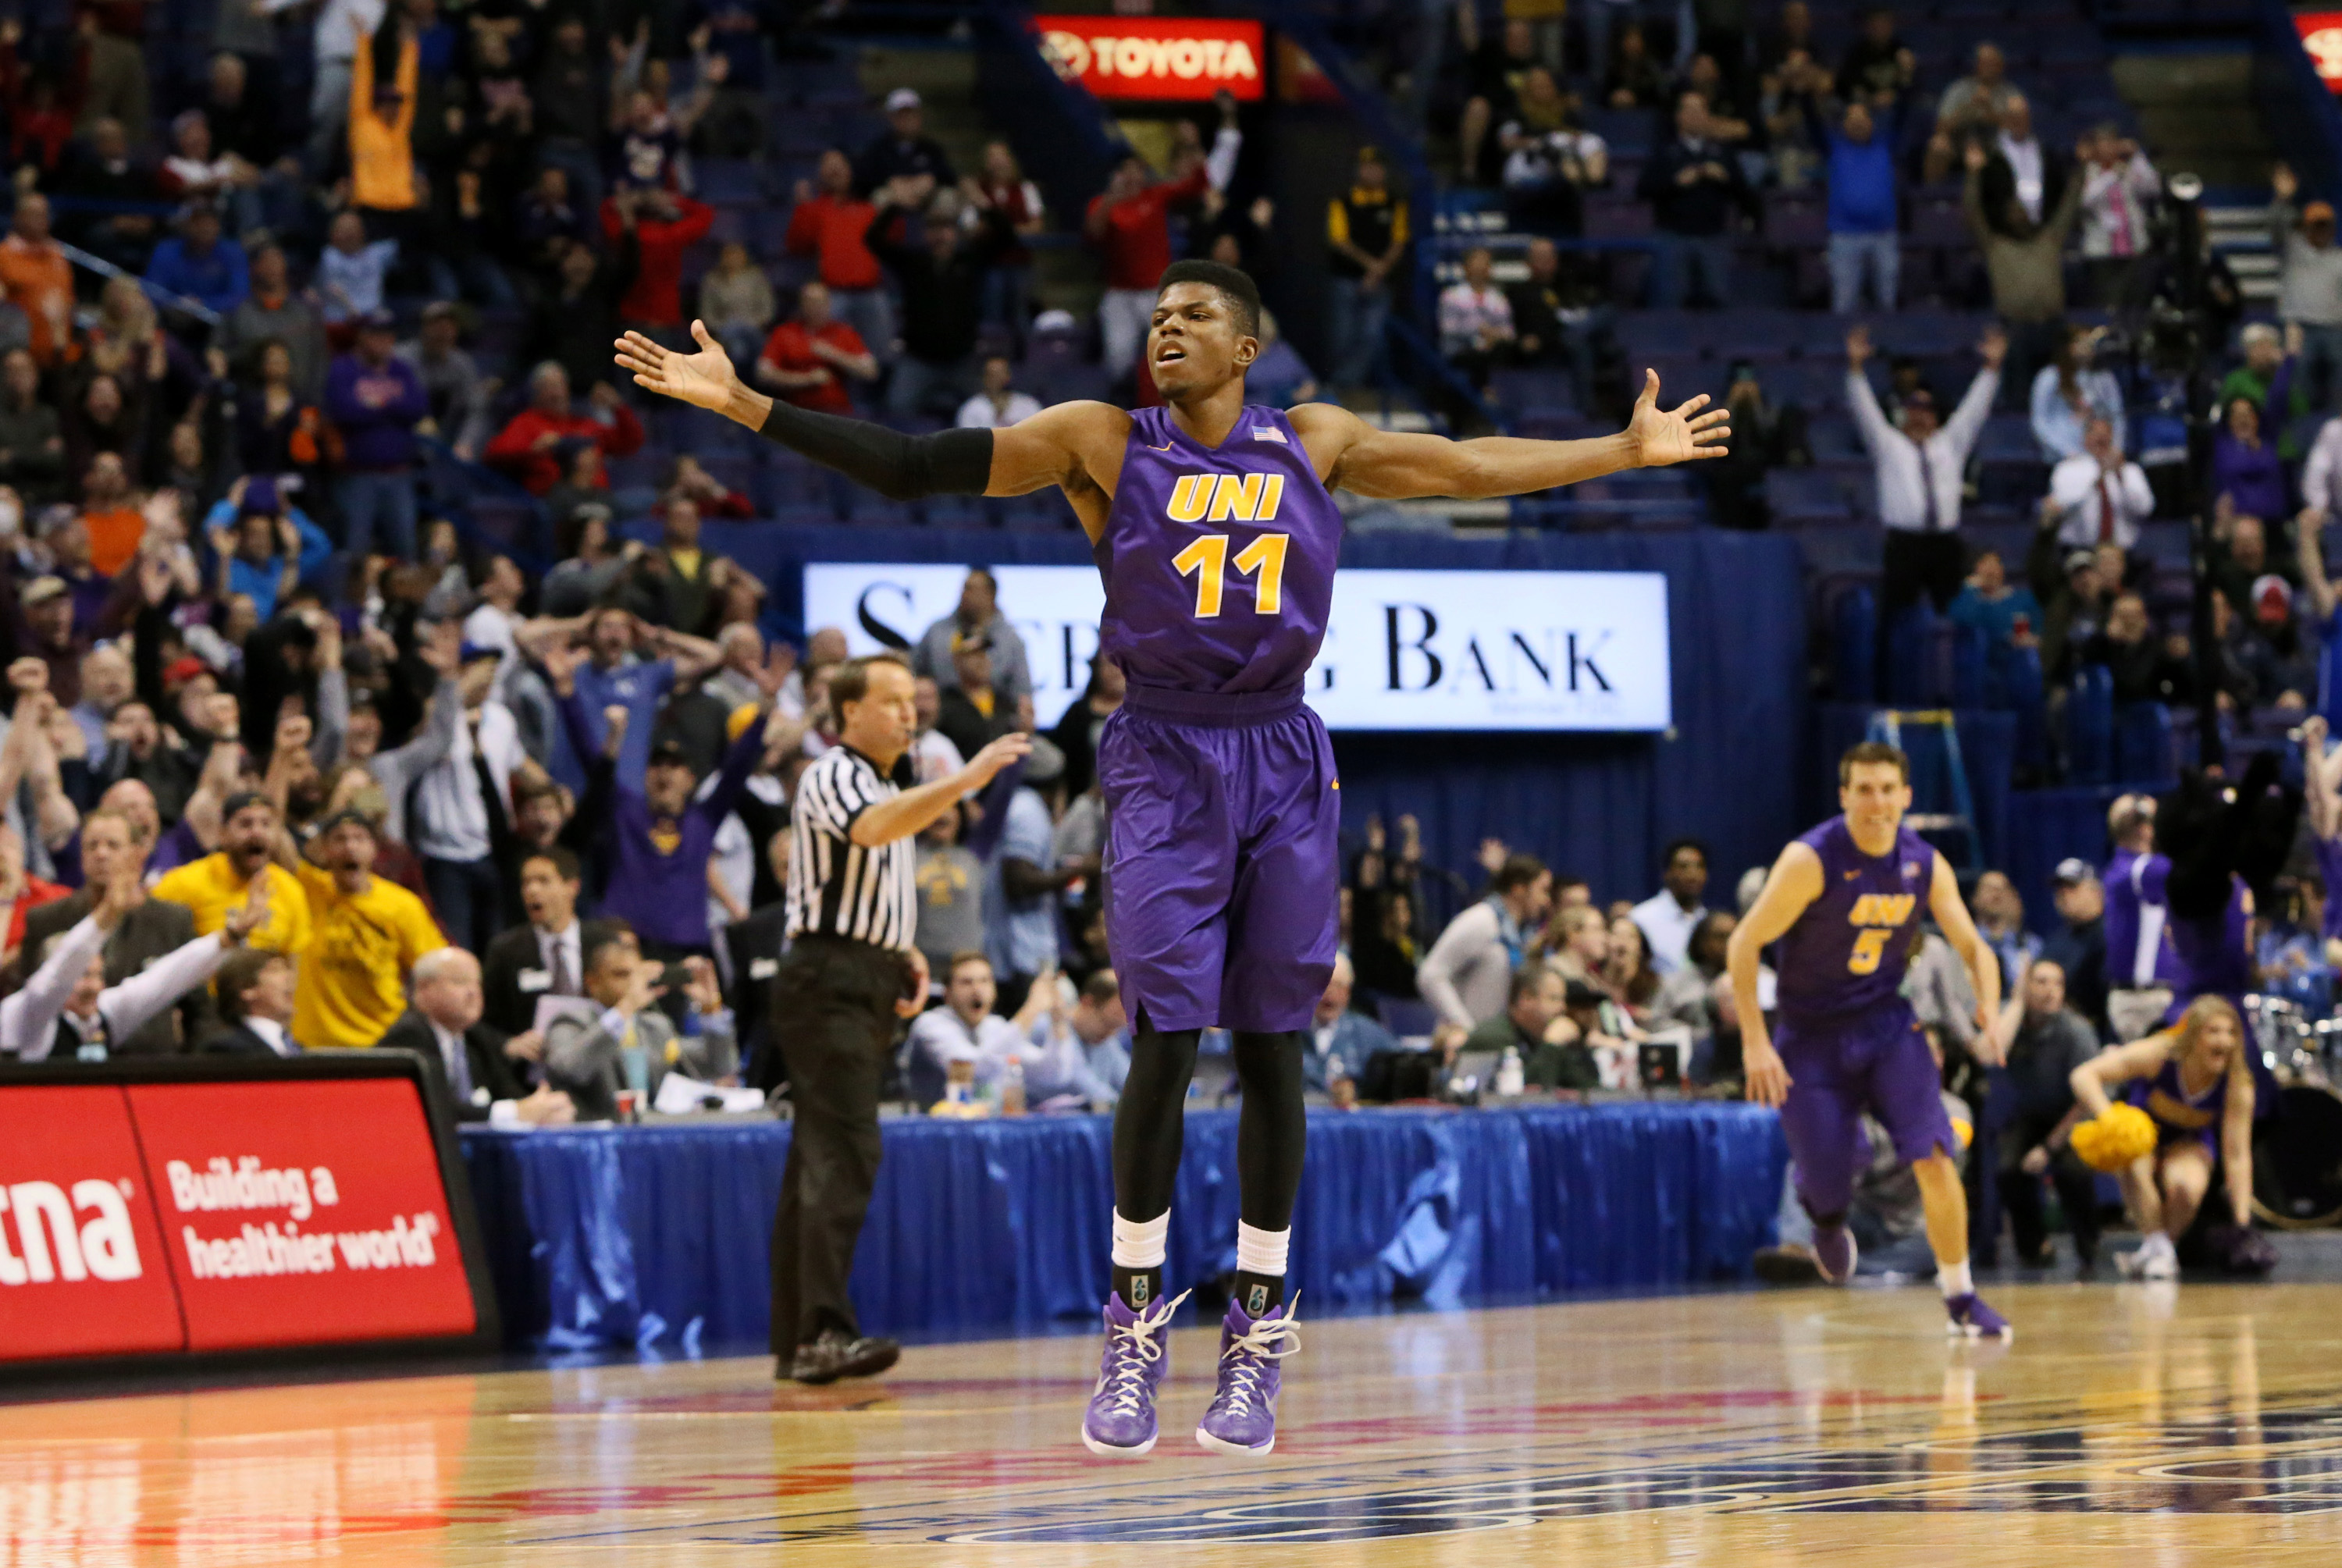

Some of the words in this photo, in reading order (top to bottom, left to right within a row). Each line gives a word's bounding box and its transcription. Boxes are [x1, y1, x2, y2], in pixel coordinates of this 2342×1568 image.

[1090, 36, 1258, 80] TOYOTA
[1166, 473, 1284, 523] UNI
[1171, 533, 1290, 618] 11
[1379, 603, 1616, 693] BANK
[1848, 928, 1893, 976] 5
[166, 1156, 312, 1221] Building
[311, 1166, 339, 1206] a
[182, 1221, 335, 1278] healthier
